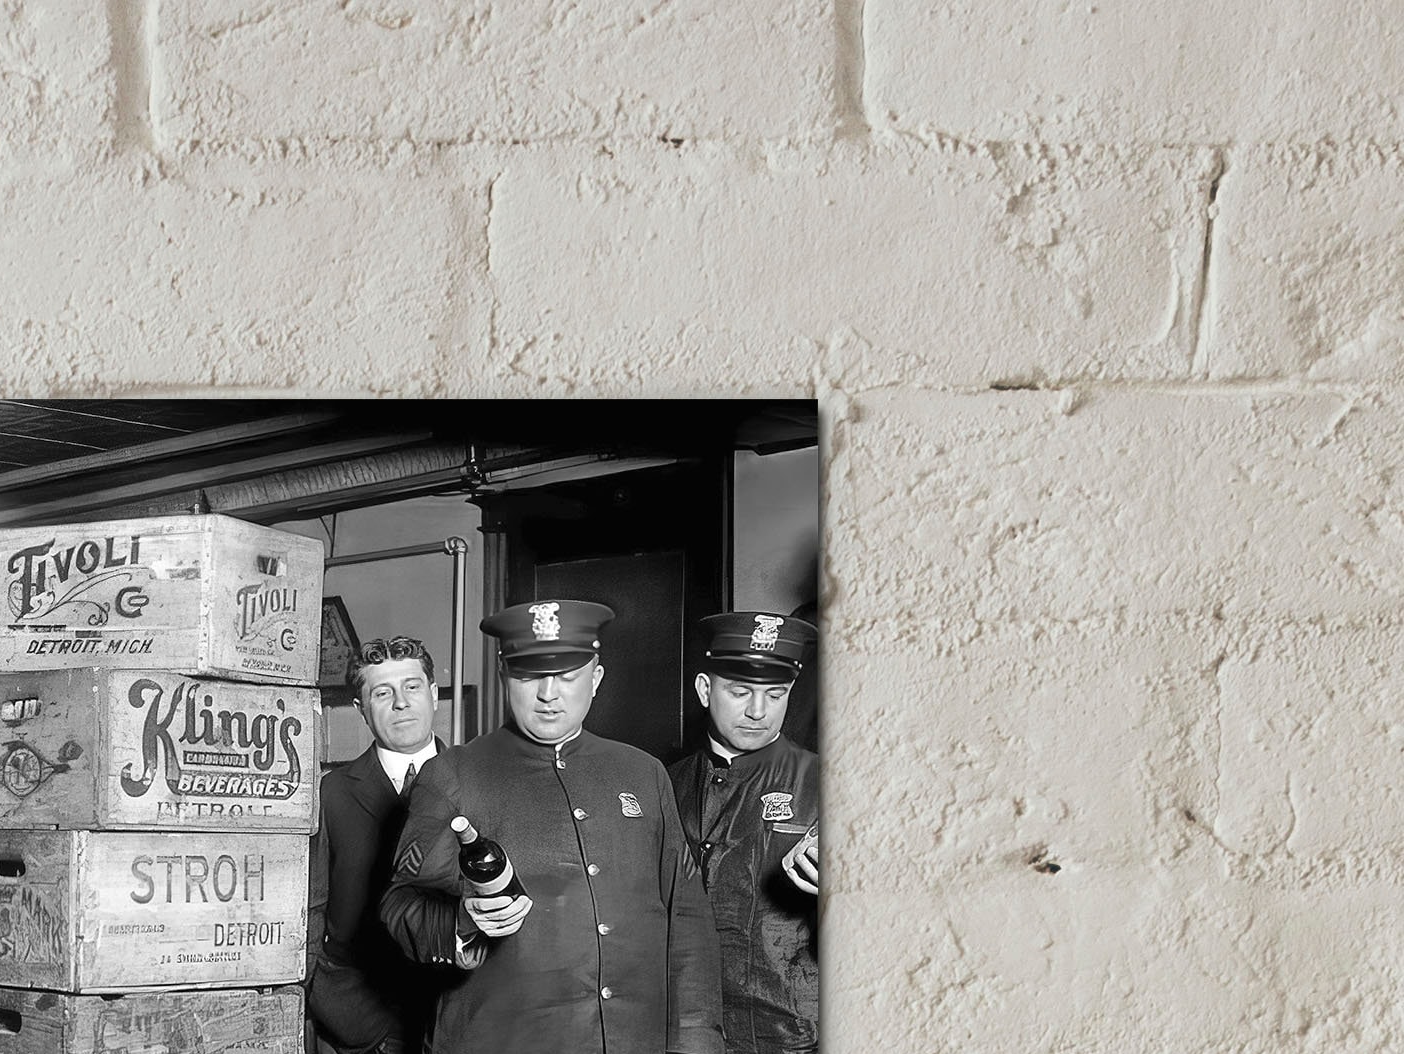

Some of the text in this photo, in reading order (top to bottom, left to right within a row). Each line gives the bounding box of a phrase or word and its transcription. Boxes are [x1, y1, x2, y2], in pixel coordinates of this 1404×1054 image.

[236, 582, 298, 640] TIVOLI
[120, 678, 302, 798] Kling's
[177, 772, 293, 798] BEVERAGES
[130, 854, 265, 905] STROH
[213, 921, 285, 948] DETROIT
